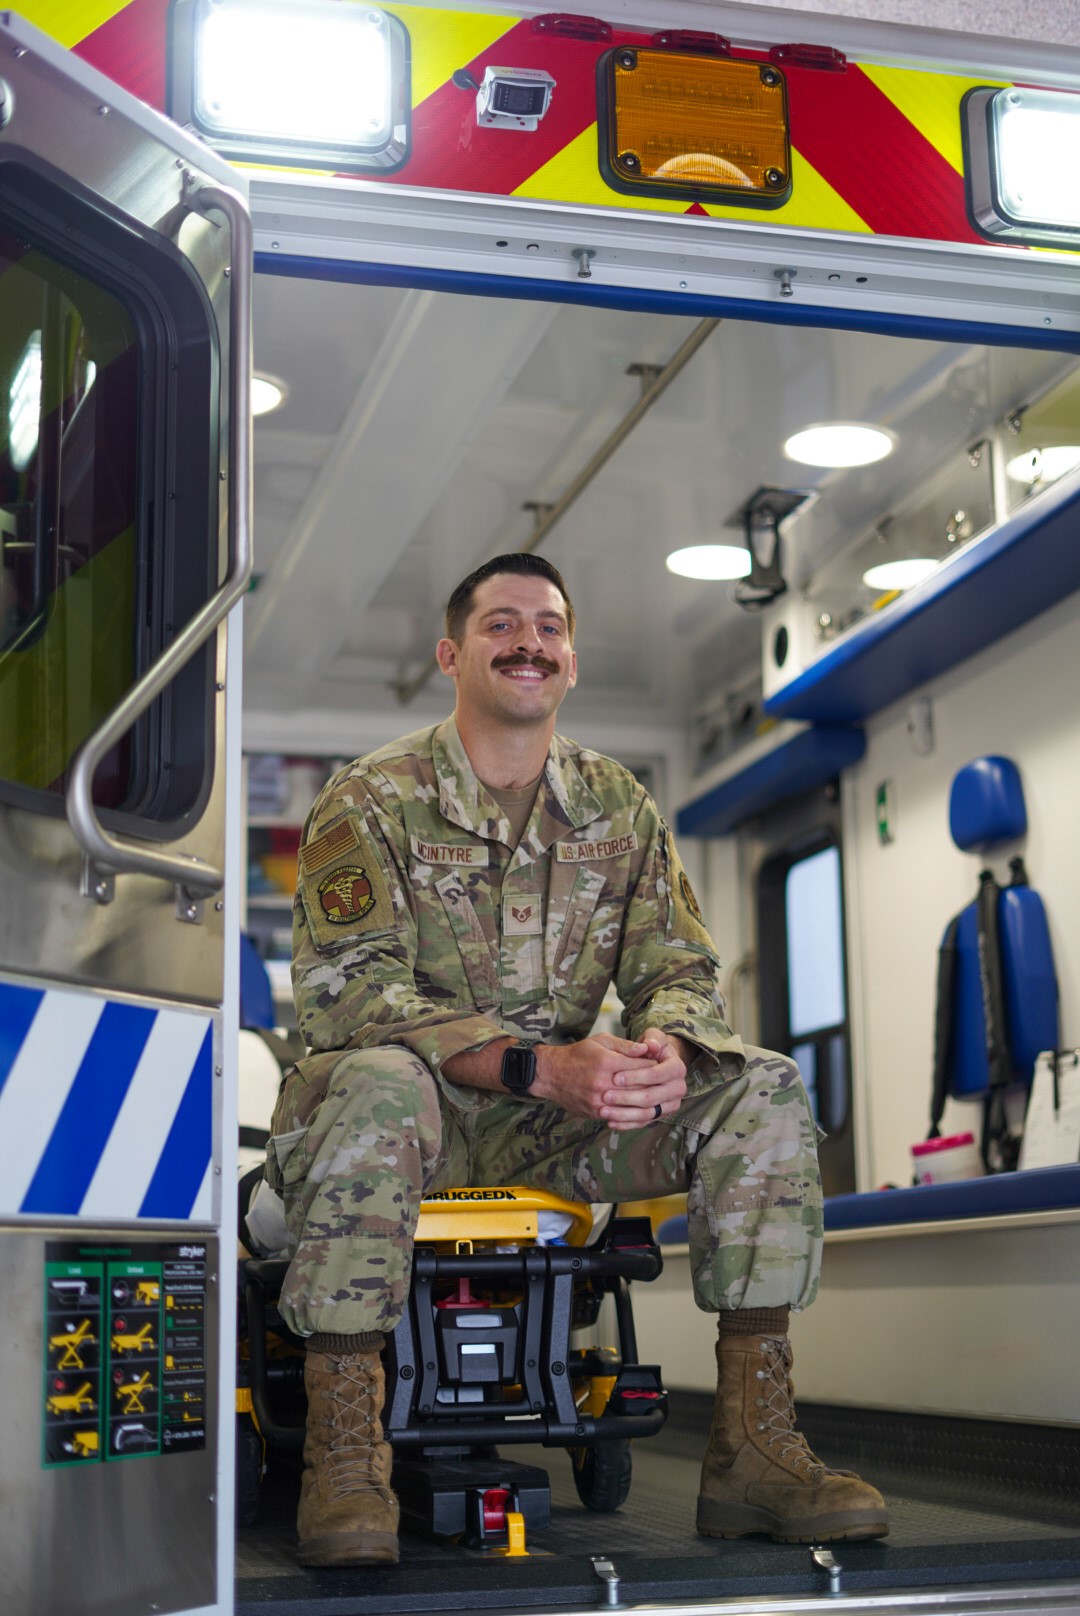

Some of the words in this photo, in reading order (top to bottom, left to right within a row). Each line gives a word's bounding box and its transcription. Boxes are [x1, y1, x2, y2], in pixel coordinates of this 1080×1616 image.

[577, 843, 596, 859] AIR
[596, 835, 635, 857] FORCE
[432, 1190, 506, 1201] RUGGED
[179, 1246, 206, 1259] stryker
